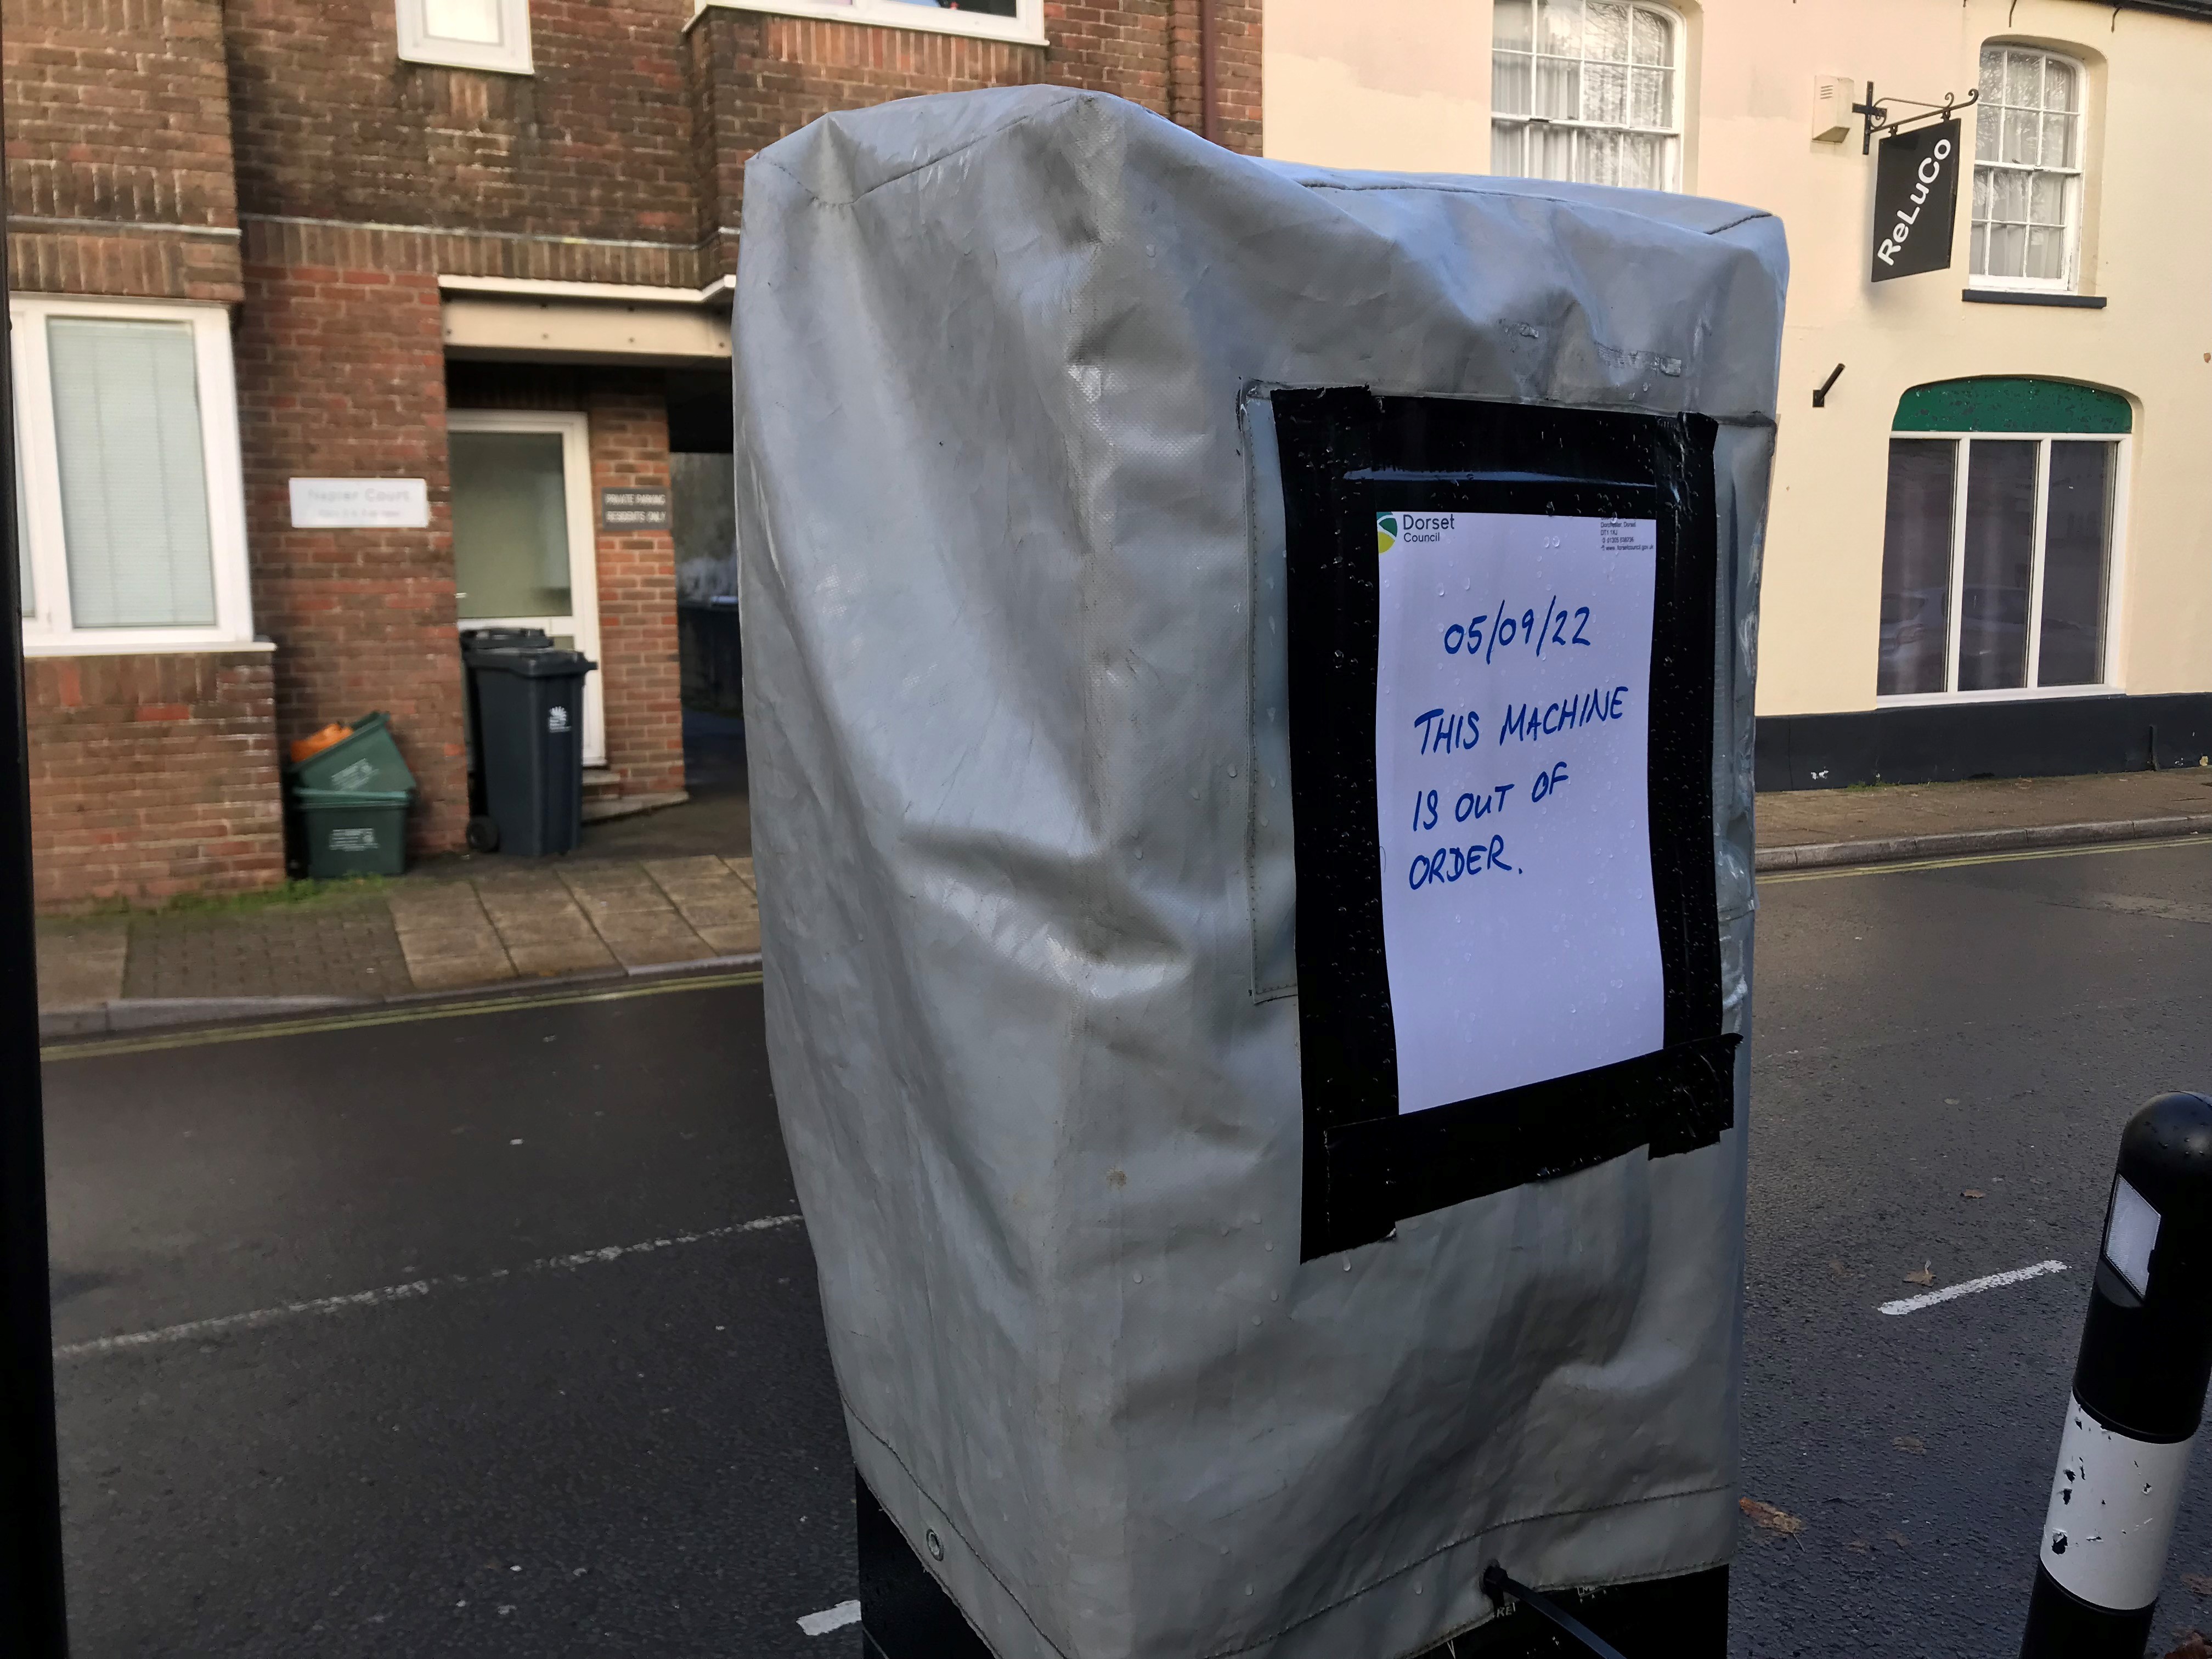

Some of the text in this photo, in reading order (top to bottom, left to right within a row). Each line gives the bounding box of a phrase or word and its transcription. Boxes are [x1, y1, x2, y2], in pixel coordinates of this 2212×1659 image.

[1877, 139, 1951, 266] ReLuCo
[365, 488, 410, 502] Court
[605, 494, 665, 505] PRIVATE PARKING
[606, 511, 666, 523] RESIDENTS ONLY
[1403, 514, 1455, 530] Dorset
[1403, 532, 1440, 543] Council
[1444, 595, 1591, 665] 05/09/22
[1414, 686, 1629, 756] THIS MACHINE
[1413, 761, 1569, 832] IS OUT OF
[1409, 834, 1523, 890] ORDER.
